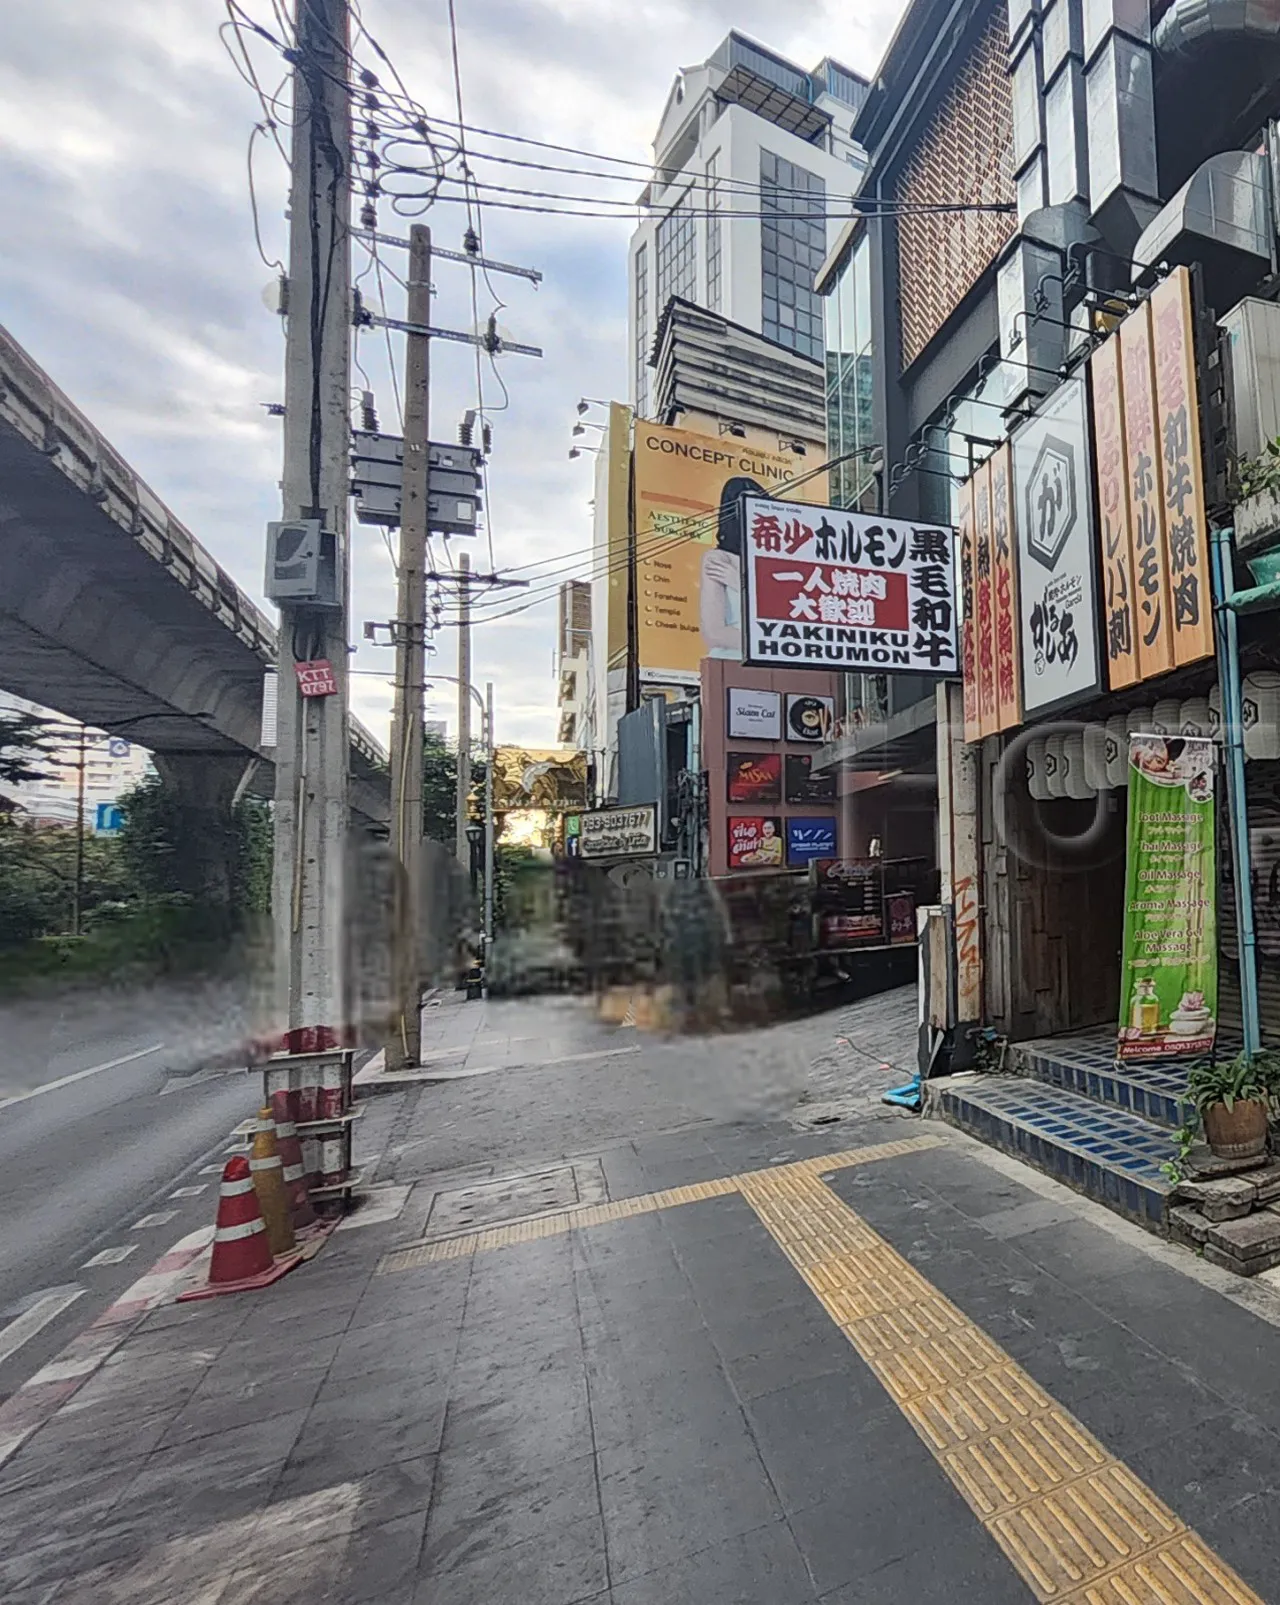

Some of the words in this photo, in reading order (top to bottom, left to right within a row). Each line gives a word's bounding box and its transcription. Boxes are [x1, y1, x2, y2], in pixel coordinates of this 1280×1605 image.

[646, 436, 735, 469] CONCEPT
[739, 458, 794, 483] CLINIC
[751, 512, 906, 569] 希少ホルモン
[772, 566, 887, 601] 一人焼肉
[909, 526, 955, 668] 黒毛和牛
[655, 606, 682, 616] Temple
[756, 621, 909, 648] YAKINIKU
[758, 640, 911, 665] HORUMON
[297, 668, 330, 682] KTT
[1138, 868, 1155, 881] Oil
[1156, 869, 1201, 882] Massage
[1129, 901, 1165, 911] Aroma
[1166, 898, 1210, 909] Massage
[1134, 930, 1158, 940] Aloe
[1159, 929, 1183, 939] Vera
[1185, 927, 1203, 938] Gel
[1145, 943, 1192, 954] Massage
